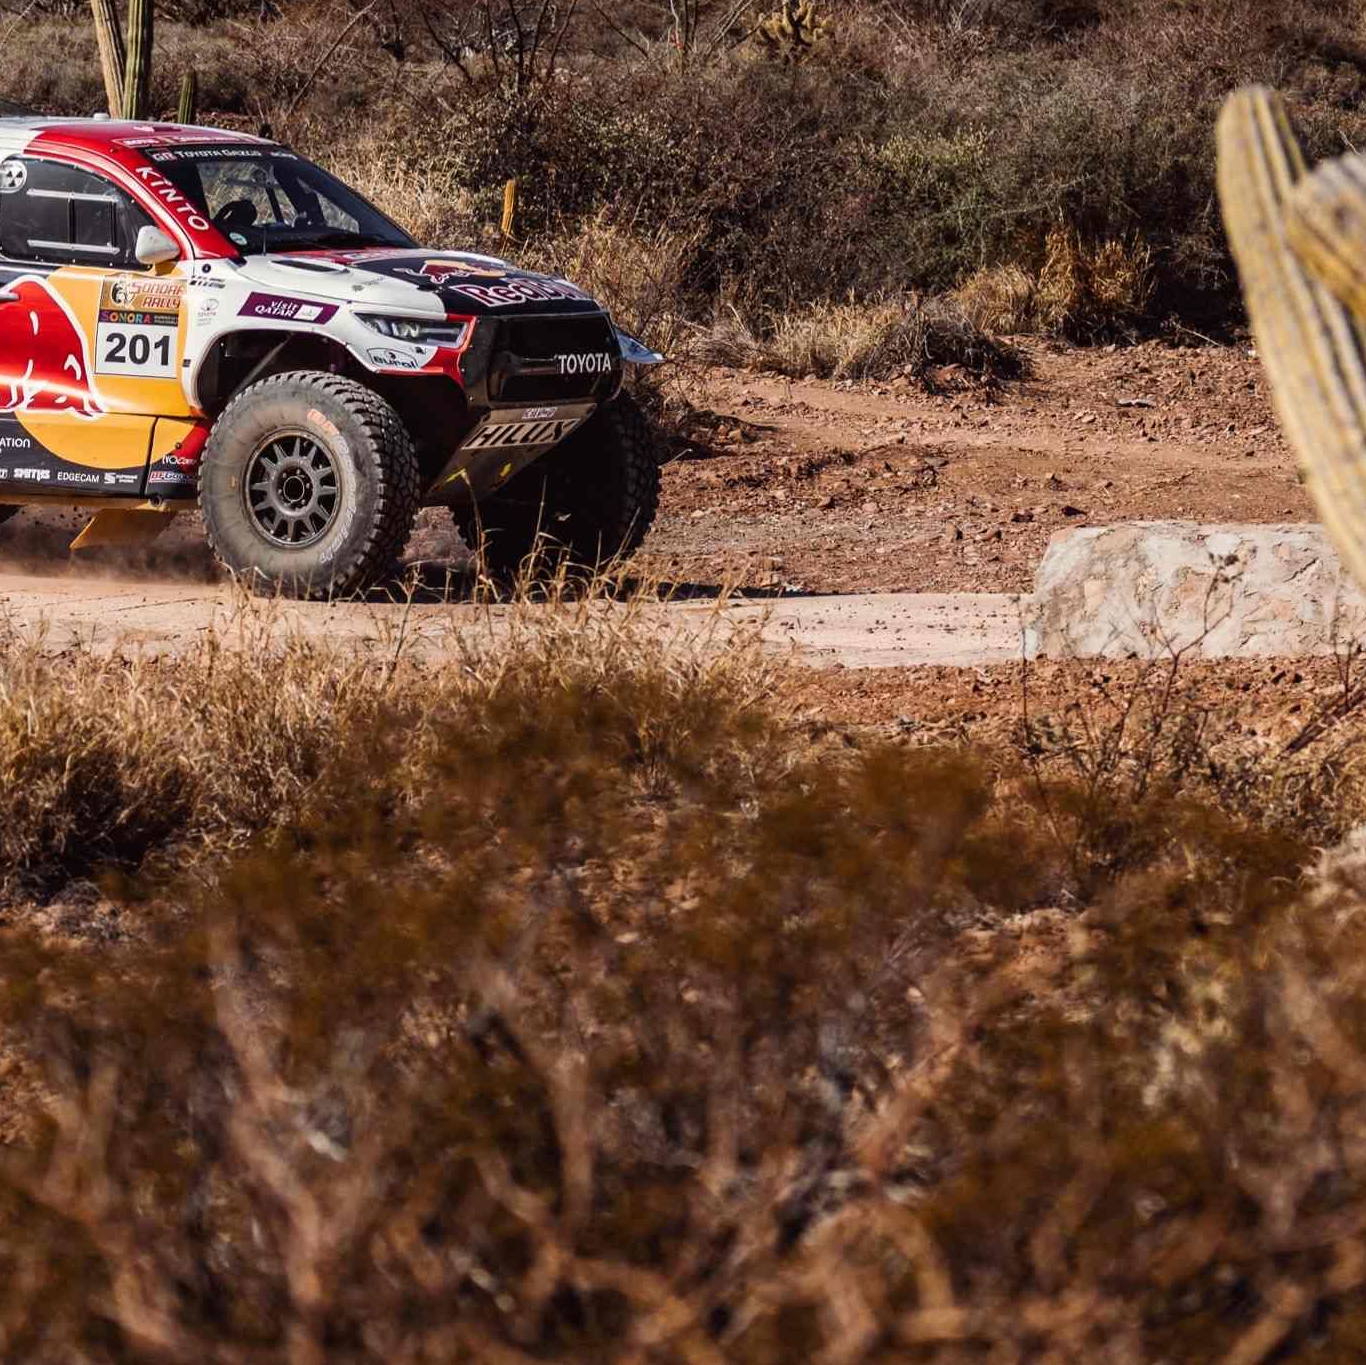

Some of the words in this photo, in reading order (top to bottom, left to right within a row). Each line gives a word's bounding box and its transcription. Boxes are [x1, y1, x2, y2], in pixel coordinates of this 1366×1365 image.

[141, 296, 181, 309] RALLY
[100, 311, 152, 325] SONORA
[254, 304, 297, 318] QATAR
[105, 332, 170, 366] 201
[557, 352, 611, 375] TOYOTA
[466, 418, 579, 447] HILUX
[57, 471, 100, 484] EDGECAM
